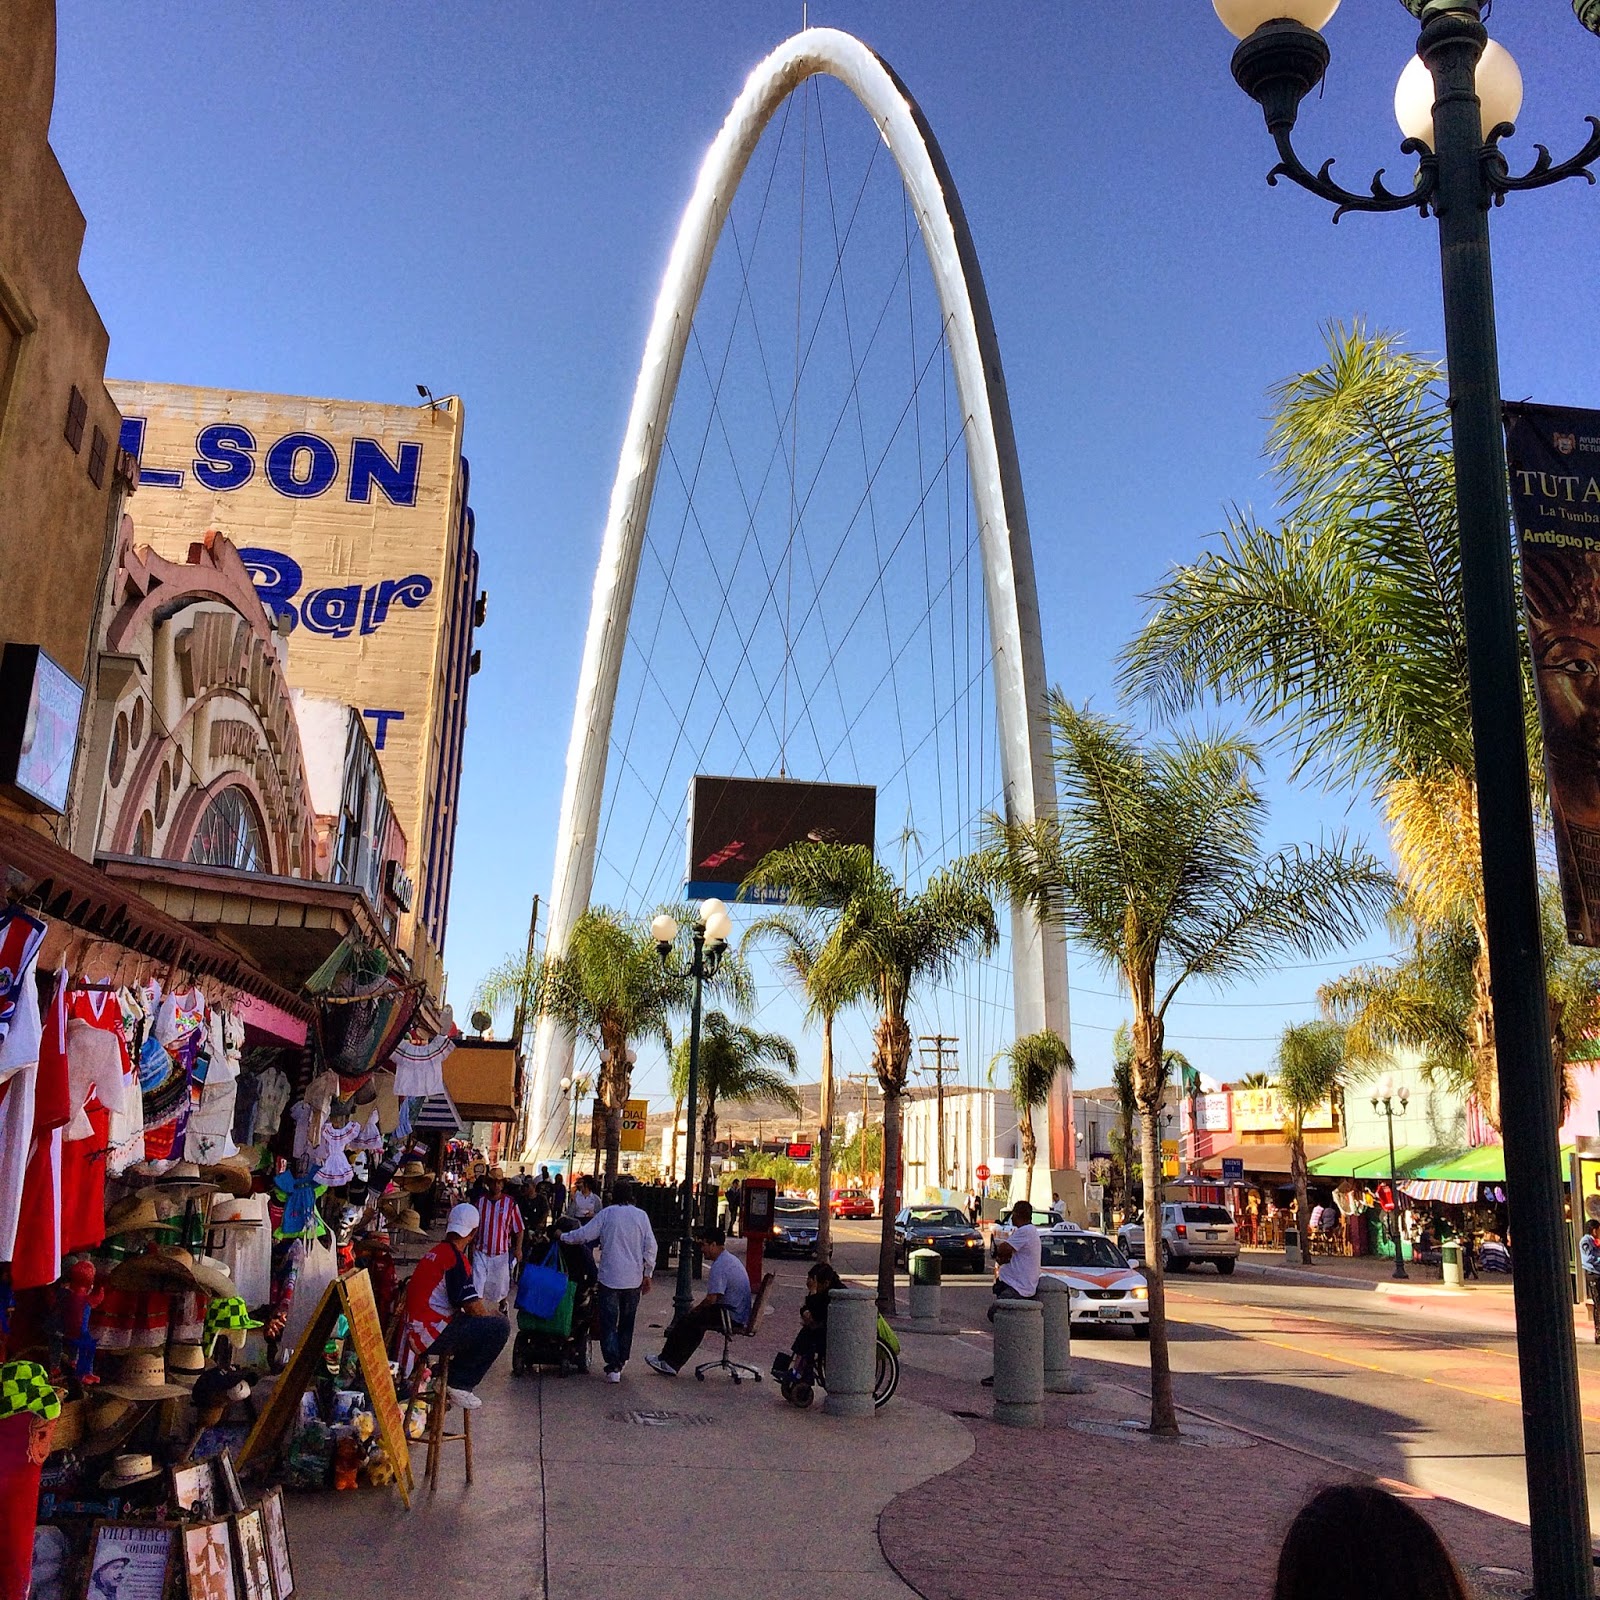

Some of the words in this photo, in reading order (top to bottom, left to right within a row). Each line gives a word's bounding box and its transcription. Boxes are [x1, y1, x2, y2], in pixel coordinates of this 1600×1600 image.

[1516, 470, 1600, 503] TUTA
[1540, 505, 1556, 517] La
[1558, 508, 1600, 523] Tumba
[1523, 528, 1583, 548] Antiguo
[237, 547, 433, 638] Bar
[209, 718, 260, 765] IMPORTS
[623, 1111, 646, 1119] DIAL
[623, 1120, 644, 1129] 078
